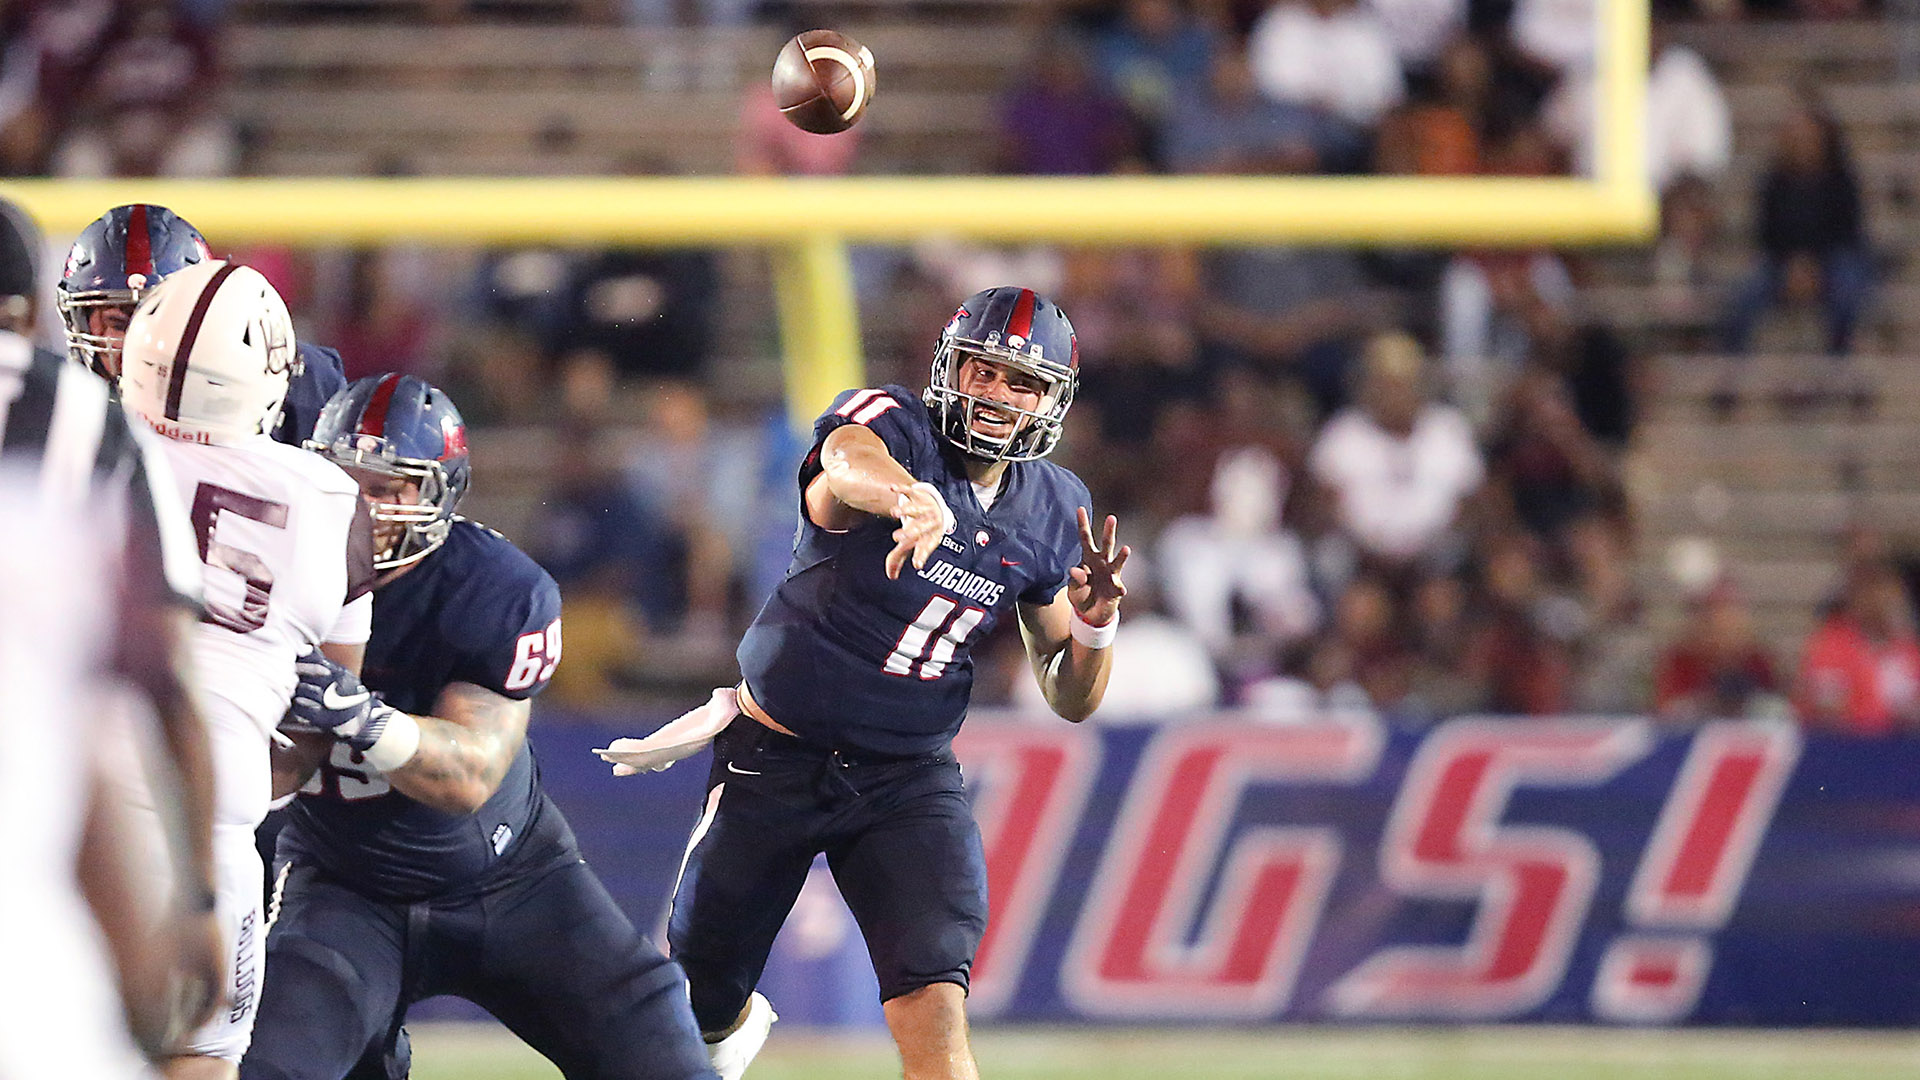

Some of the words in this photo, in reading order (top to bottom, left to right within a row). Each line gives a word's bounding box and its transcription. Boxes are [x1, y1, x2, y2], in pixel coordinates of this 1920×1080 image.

[834, 388, 902, 426] 11
[942, 536, 965, 554] BELT
[917, 559, 1005, 607] JAGUARS
[504, 618, 563, 691] 69
[881, 593, 986, 680] 11
[229, 908, 255, 1024] BULLDOGS
